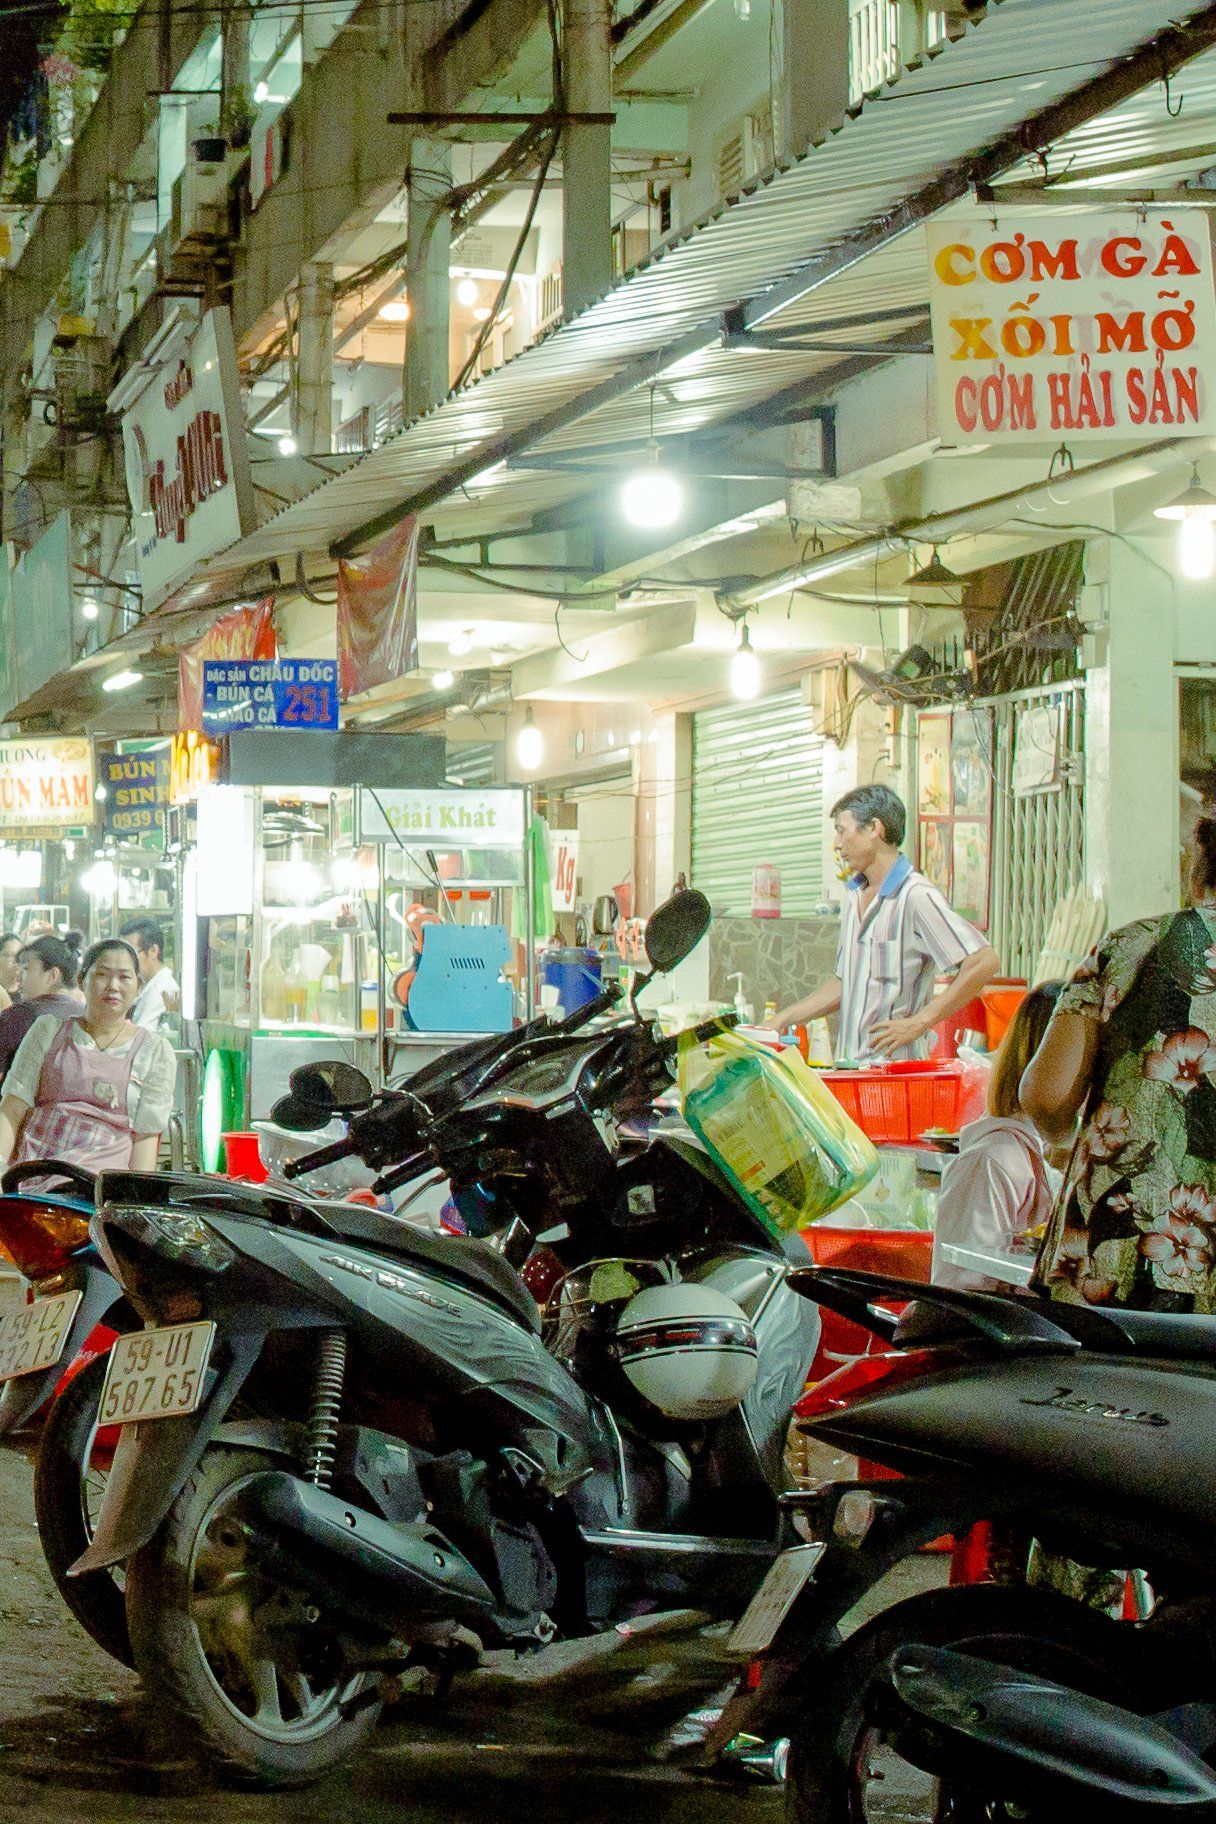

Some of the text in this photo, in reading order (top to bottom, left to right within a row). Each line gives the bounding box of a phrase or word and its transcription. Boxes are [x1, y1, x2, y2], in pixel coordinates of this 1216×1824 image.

[935, 220, 1202, 287] CƠM GÀ
[948, 289, 1196, 361] XỐI MỠ
[954, 347, 1199, 433] CƠM HẢI SẢN
[299, 661, 333, 682] ĐỐC
[217, 683, 275, 701] BÚN CÁ
[284, 685, 332, 722] 251
[109, 756, 156, 781] BÚN
[385, 800, 496, 829] Giải Khát
[123, 1329, 195, 1375] 59-U1
